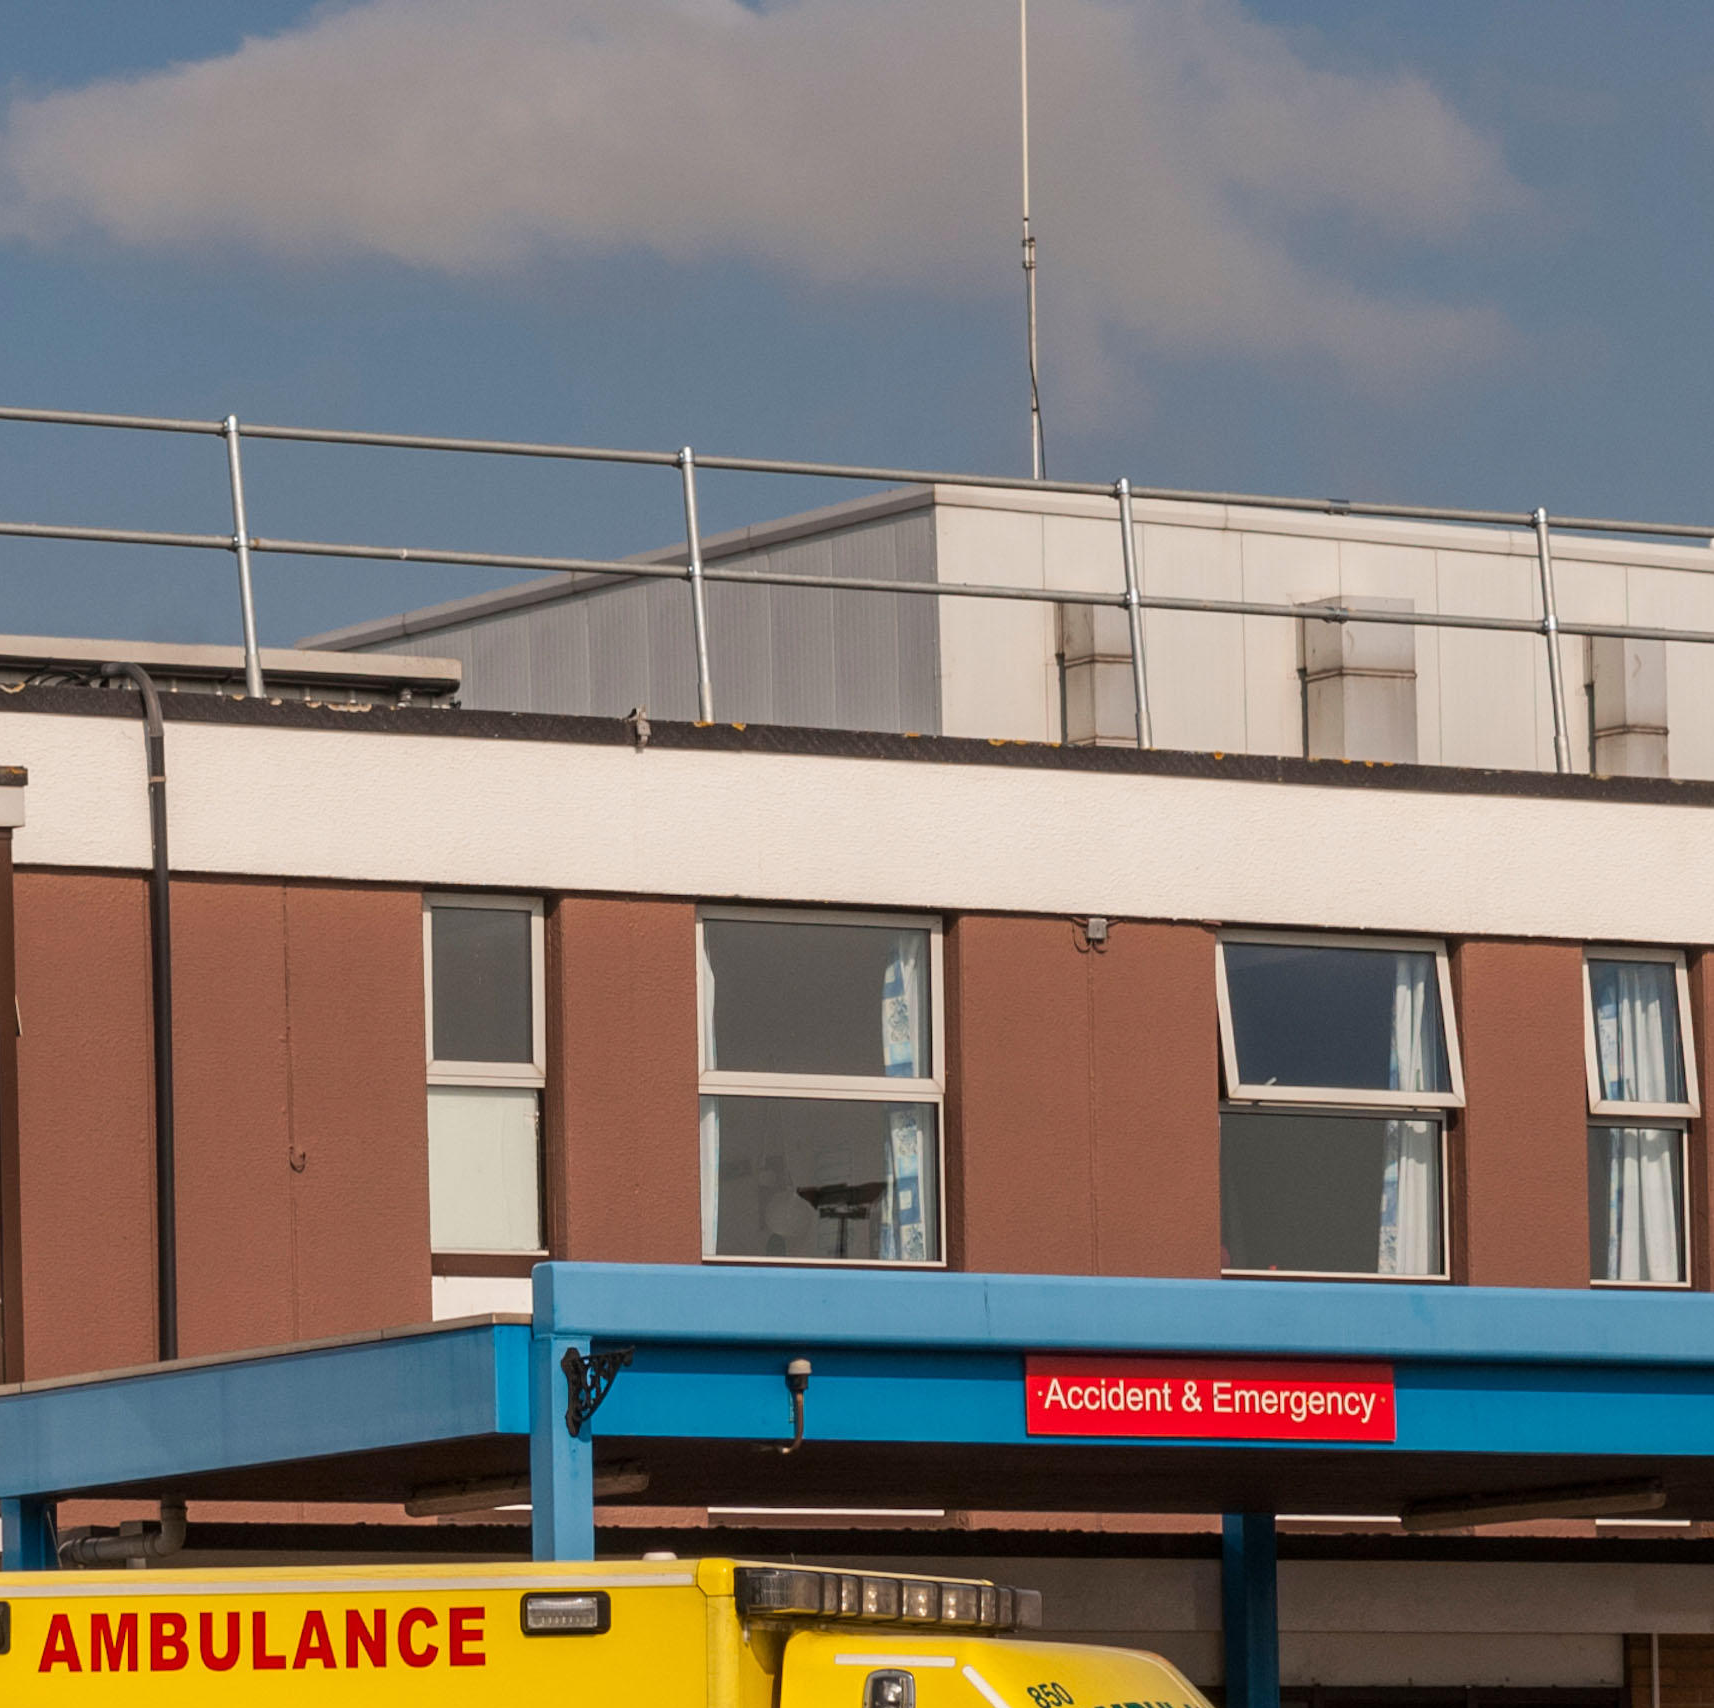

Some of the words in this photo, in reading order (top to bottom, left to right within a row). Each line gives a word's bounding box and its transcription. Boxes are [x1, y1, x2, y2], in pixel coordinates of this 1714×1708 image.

[1044, 1378, 1172, 1411] Accident
[1181, 1381, 1202, 1412] &
[1213, 1382, 1376, 1424] Emergency
[37, 1606, 487, 1673] AMBULANCE
